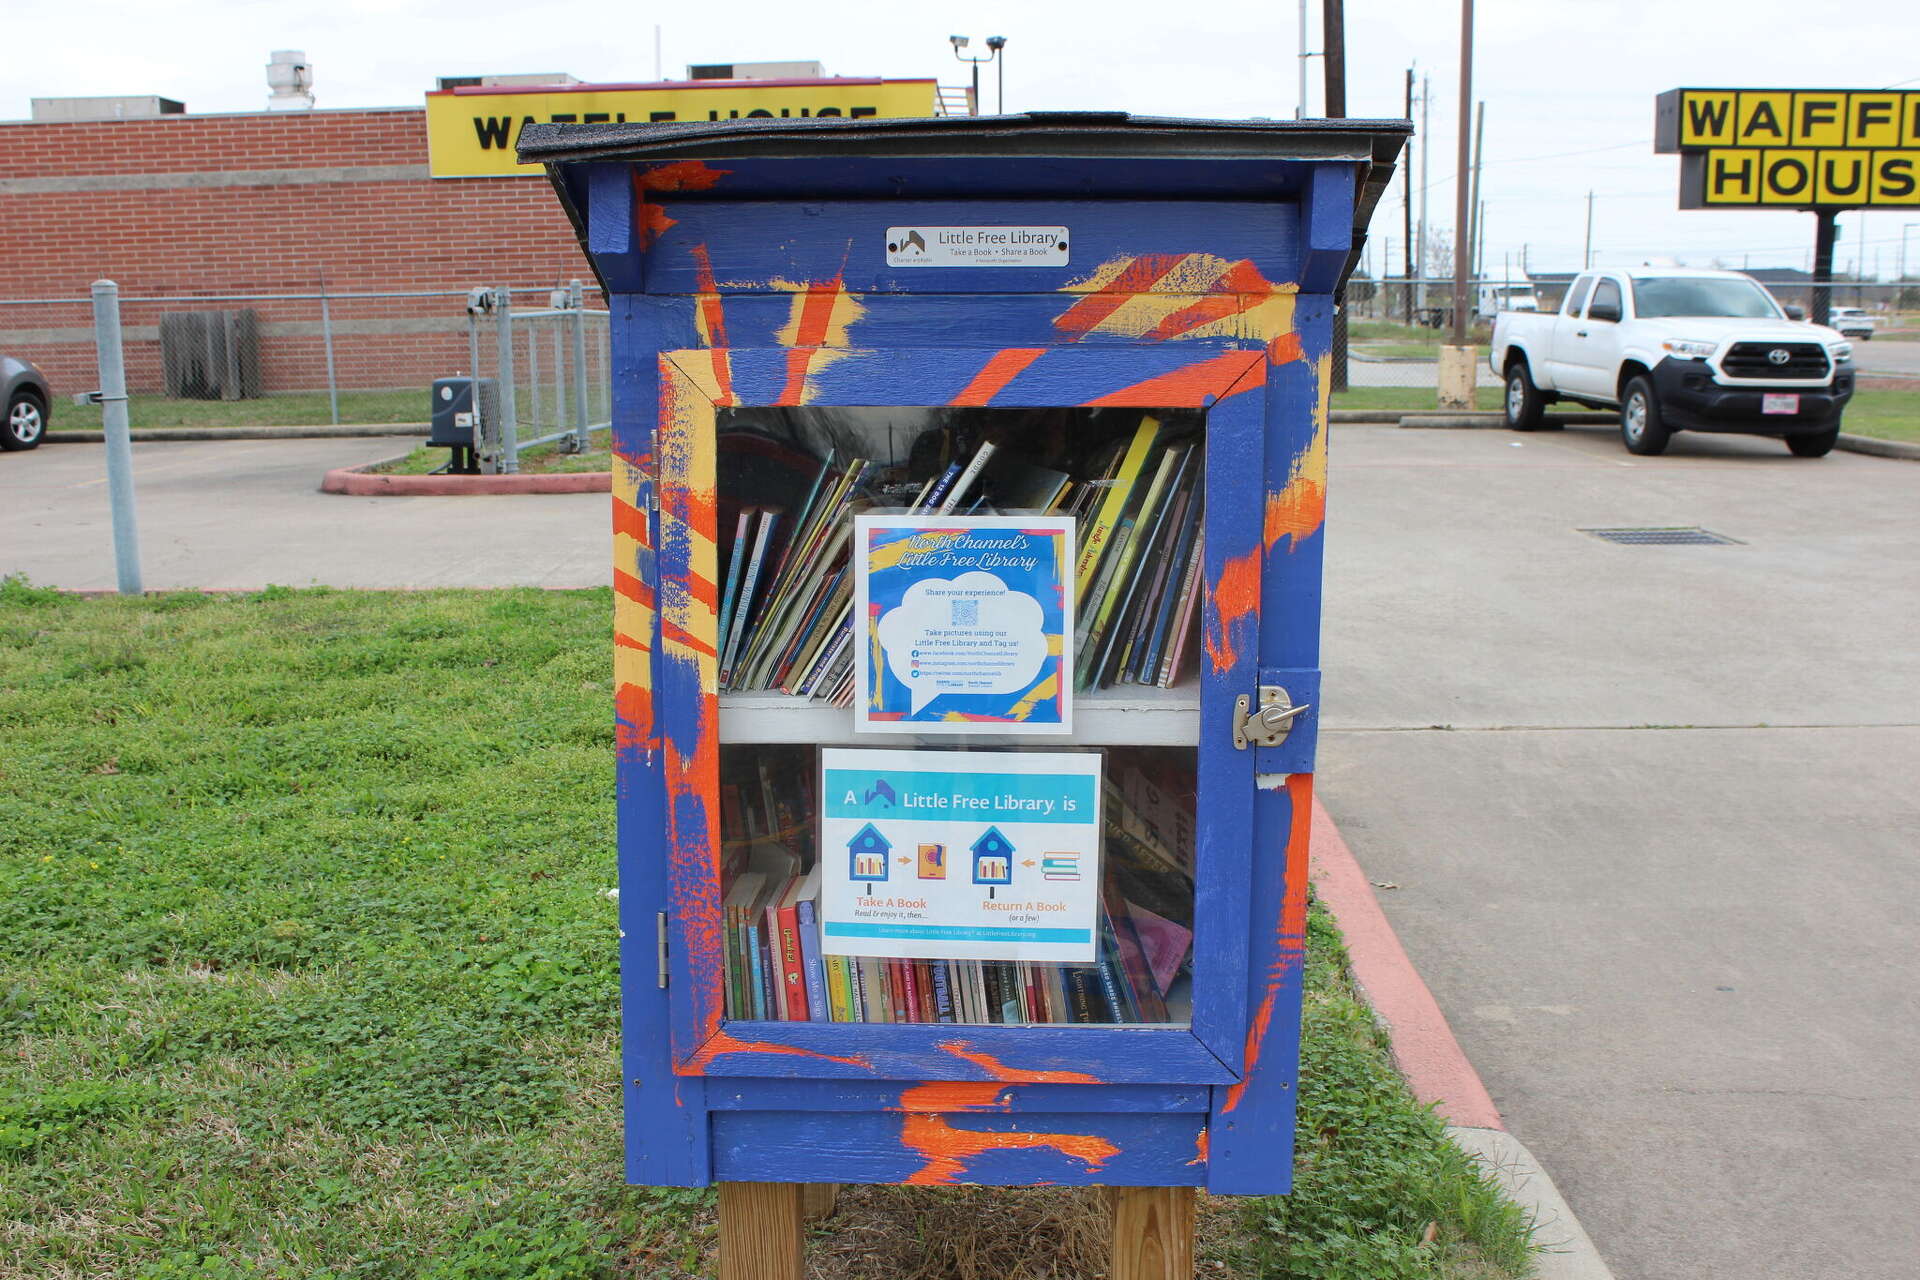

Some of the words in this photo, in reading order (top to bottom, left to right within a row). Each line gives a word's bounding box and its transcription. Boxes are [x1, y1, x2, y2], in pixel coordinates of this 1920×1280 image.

[1688, 100, 1920, 138] WAFF
[1714, 157, 1917, 197] HOUS
[939, 231, 974, 244] Little
[977, 231, 1006, 244] Free
[1010, 230, 1058, 247] Library
[907, 534, 953, 550] North
[954, 534, 1030, 550] Channel's
[897, 552, 940, 570] Little
[939, 552, 977, 567] Free
[976, 552, 1038, 572] Library
[947, 590, 964, 598] your
[964, 589, 1006, 598] experience!
[952, 640, 978, 648] Library
[994, 640, 1006, 648] Tag
[844, 790, 856, 804] A
[904, 793, 948, 808] Little
[952, 795, 990, 810] Free
[994, 795, 1054, 815] Library
[1063, 796, 1076, 812] is
[856, 896, 884, 907] Take
[886, 898, 894, 908] A
[898, 898, 927, 908] Book
[982, 901, 1022, 911] Return
[1026, 902, 1033, 911] A
[1037, 902, 1066, 912] Book
[880, 911, 898, 919] enjoy
[1009, 914, 1019, 922] (or
[1024, 914, 1040, 923] few)
